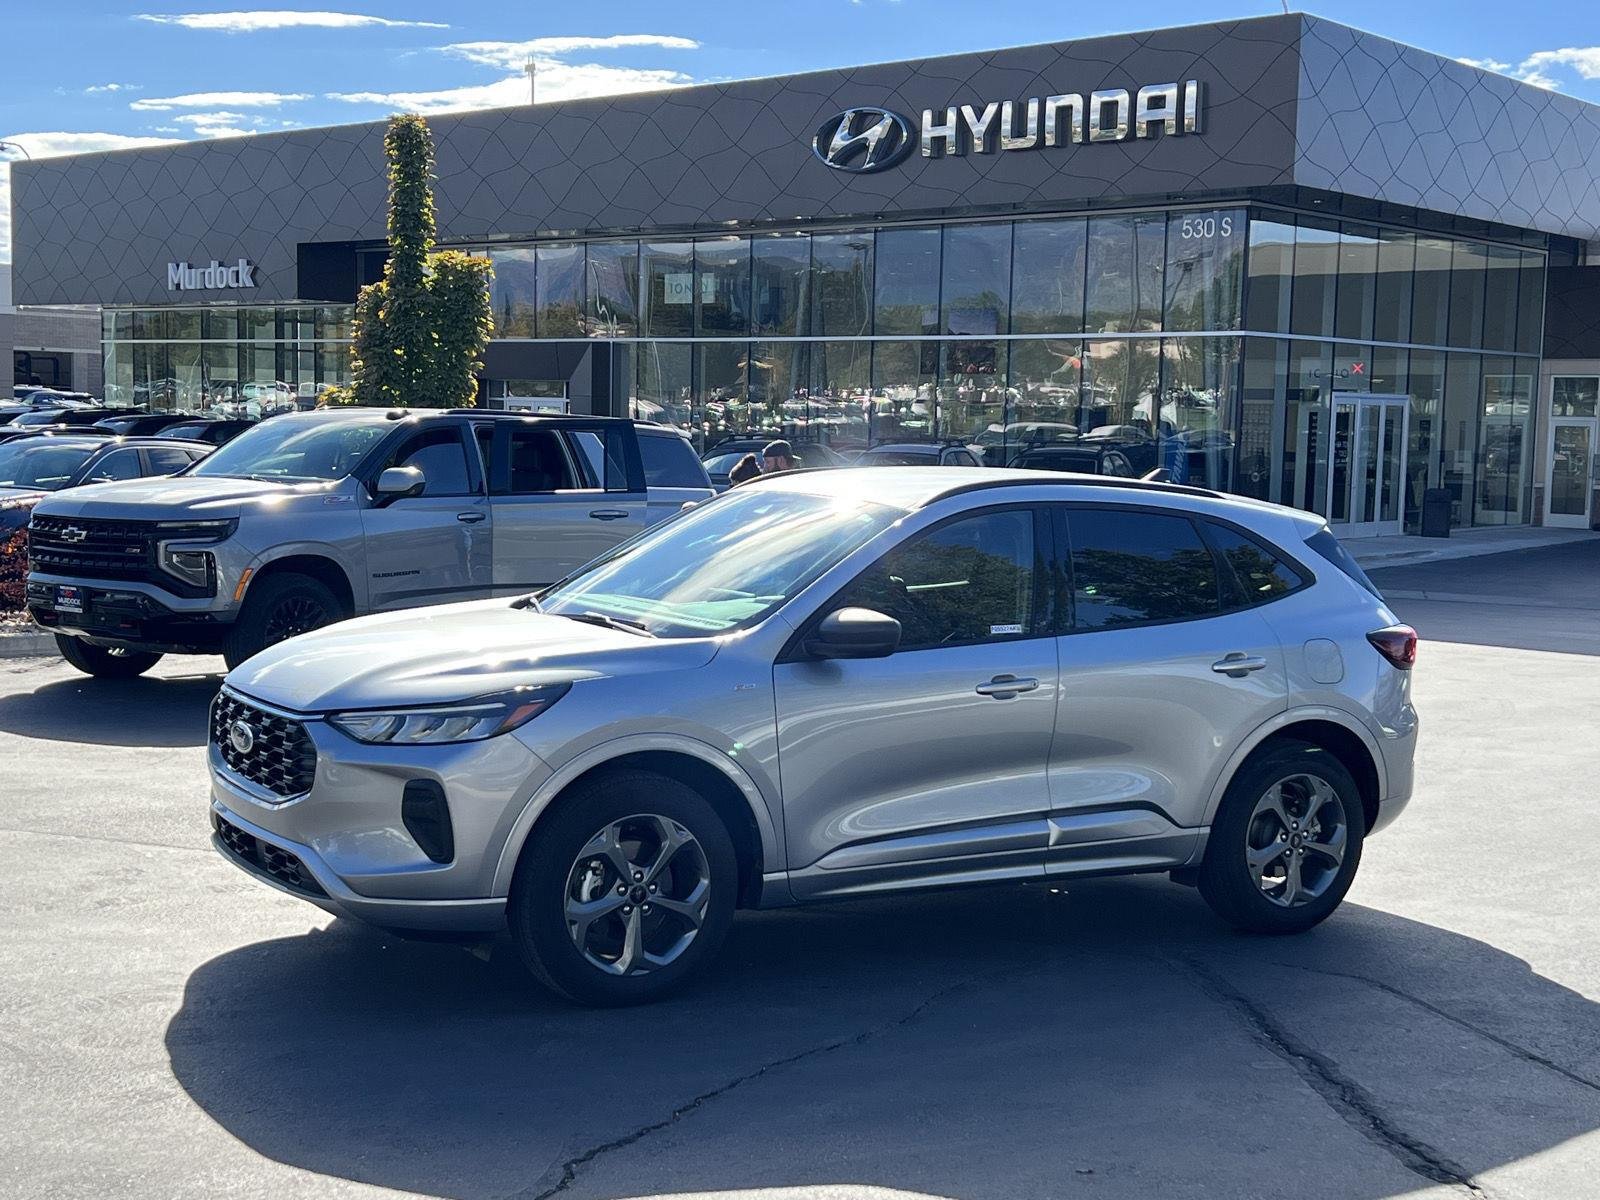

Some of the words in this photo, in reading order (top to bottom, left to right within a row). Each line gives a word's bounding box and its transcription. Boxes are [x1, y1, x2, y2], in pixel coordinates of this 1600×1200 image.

[921, 80, 1199, 158] HYUNDAI
[1181, 218, 1216, 239] 530
[1221, 217, 1232, 237] S
[167, 258, 256, 291] Murdock
